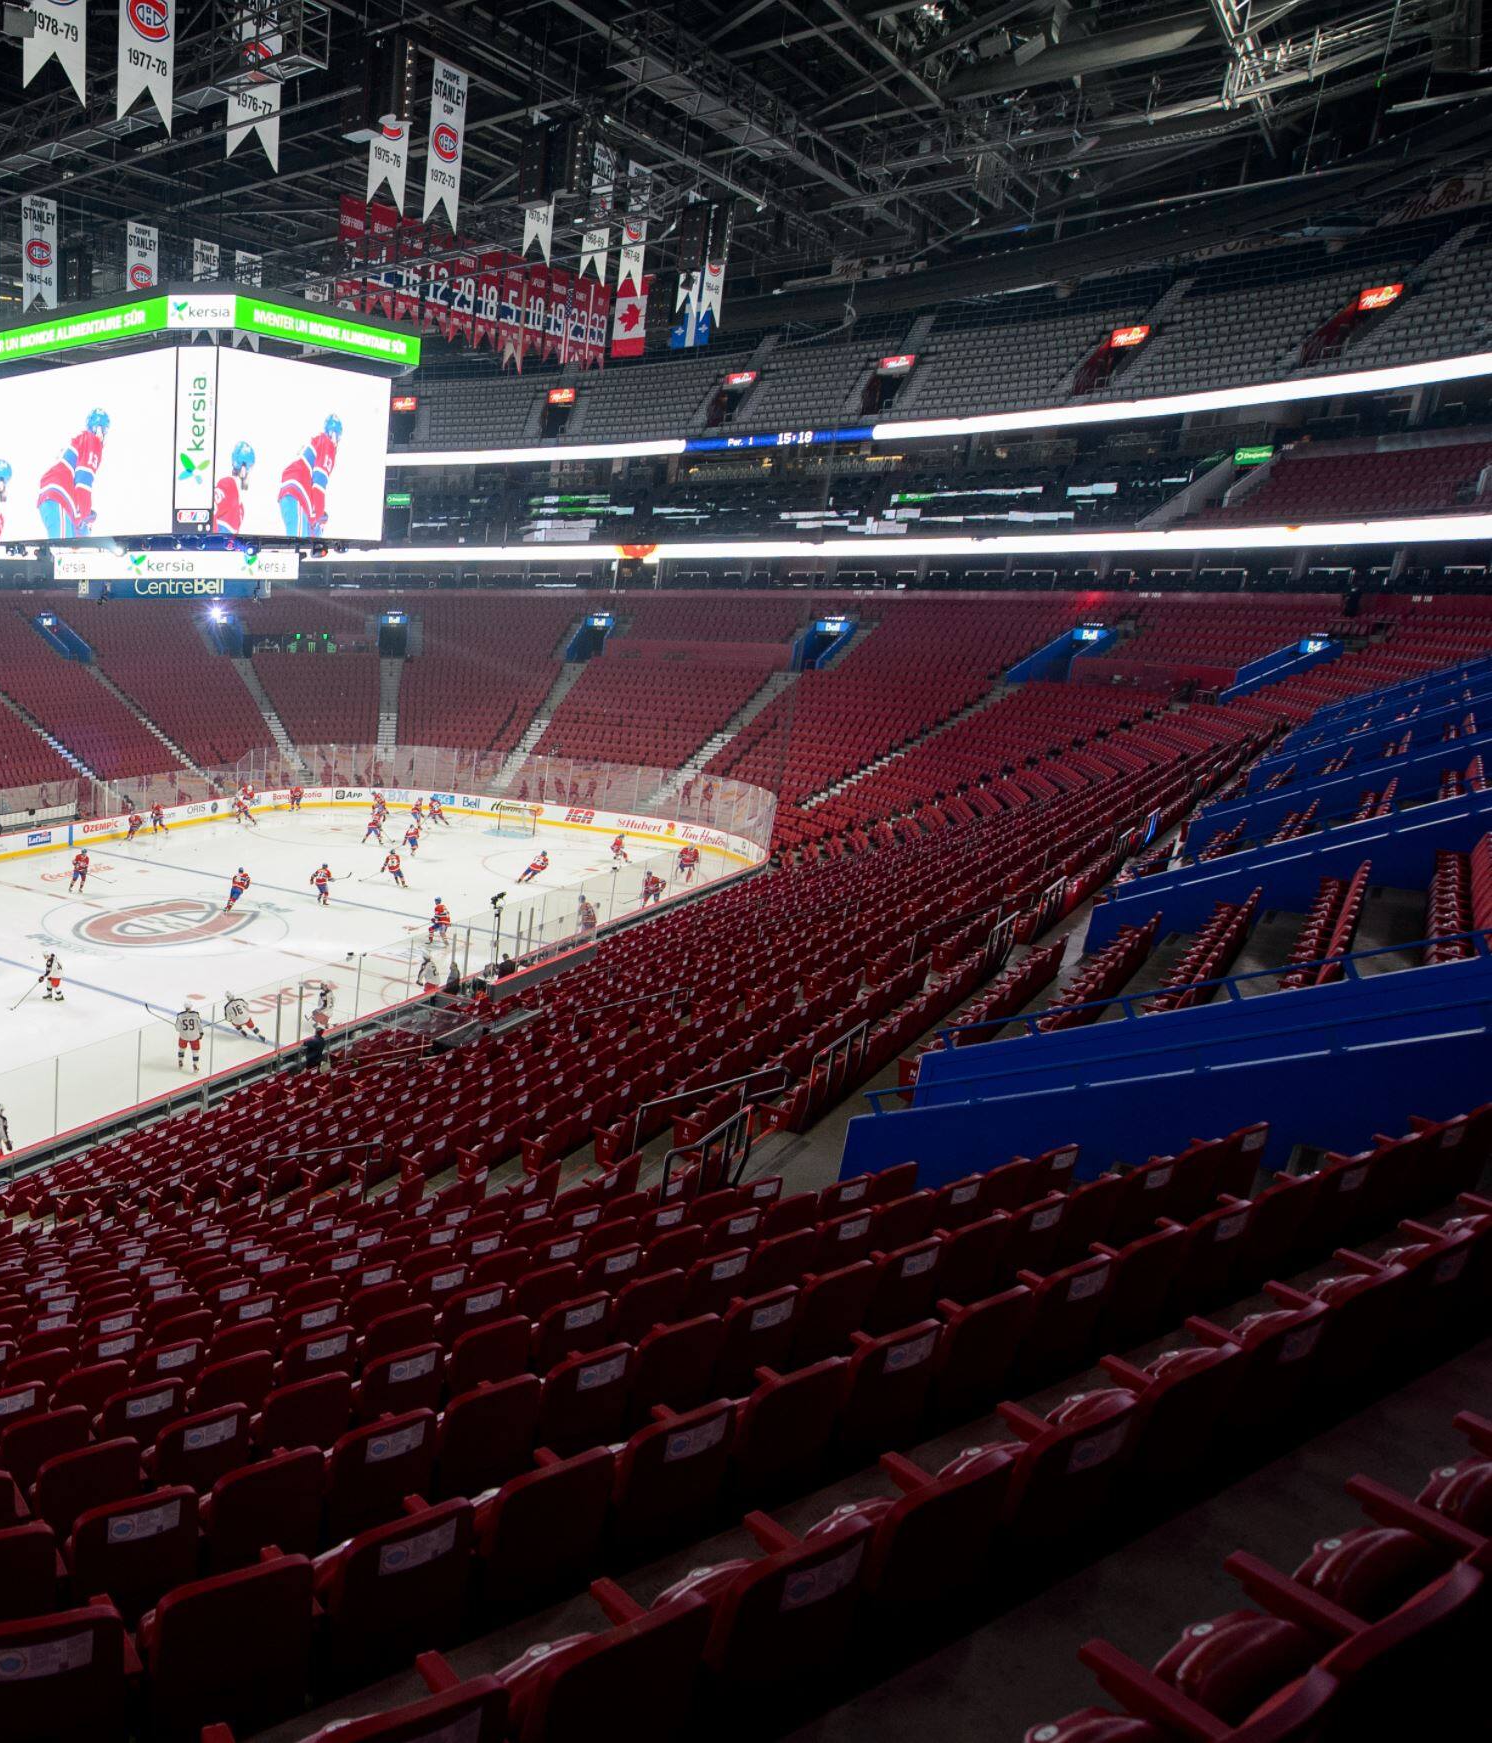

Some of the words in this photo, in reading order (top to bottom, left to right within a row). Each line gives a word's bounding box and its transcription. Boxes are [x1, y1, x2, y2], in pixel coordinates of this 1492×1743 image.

[33, 12, 79, 43] 1978-79
[127, 47, 168, 77] 1977-78
[434, 78, 466, 108] STANLEY
[236, 92, 273, 113] 1976-77
[443, 103, 454, 115] CUP
[374, 146, 401, 168] 1975-76
[430, 168, 456, 189] 1972-73
[23, 206, 56, 228] STANLEY
[34, 223, 45, 233] CUP
[128, 235, 157, 252] STANLEY
[454, 278, 475, 314] 29
[481, 284, 498, 321] 18
[1362, 292, 1398, 307] Molson
[188, 306, 231, 318] kersia
[509, 290, 519, 326] 5
[550, 301, 565, 336] 19
[570, 308, 588, 342] 23
[7, 338, 19, 352] UN
[20, 330, 55, 349] MONDE
[56, 316, 122, 341] ALIMENTAIRE
[123, 309, 146, 327] SÛR
[253, 308, 294, 330] INVENTER
[295, 318, 308, 333] UN
[309, 320, 340, 340] MONDE
[340, 327, 391, 351] ALIMENTAIRE
[1114, 333, 1145, 345] Molson
[187, 376, 207, 451] kersia
[727, 438, 744, 447] Per.
[748, 436, 754, 445] 1
[88, 452, 99, 469] 13
[147, 558, 194, 573] kersia
[825, 622, 840, 631] Bell
[1082, 629, 1098, 640] Bell
[438, 795, 452, 805] 5G
[463, 797, 480, 808] Bell
[187, 804, 206, 815] ORIS
[565, 808, 596, 824] IGA
[680, 825, 699, 839] Tim
[182, 1018, 195, 1031] 59
